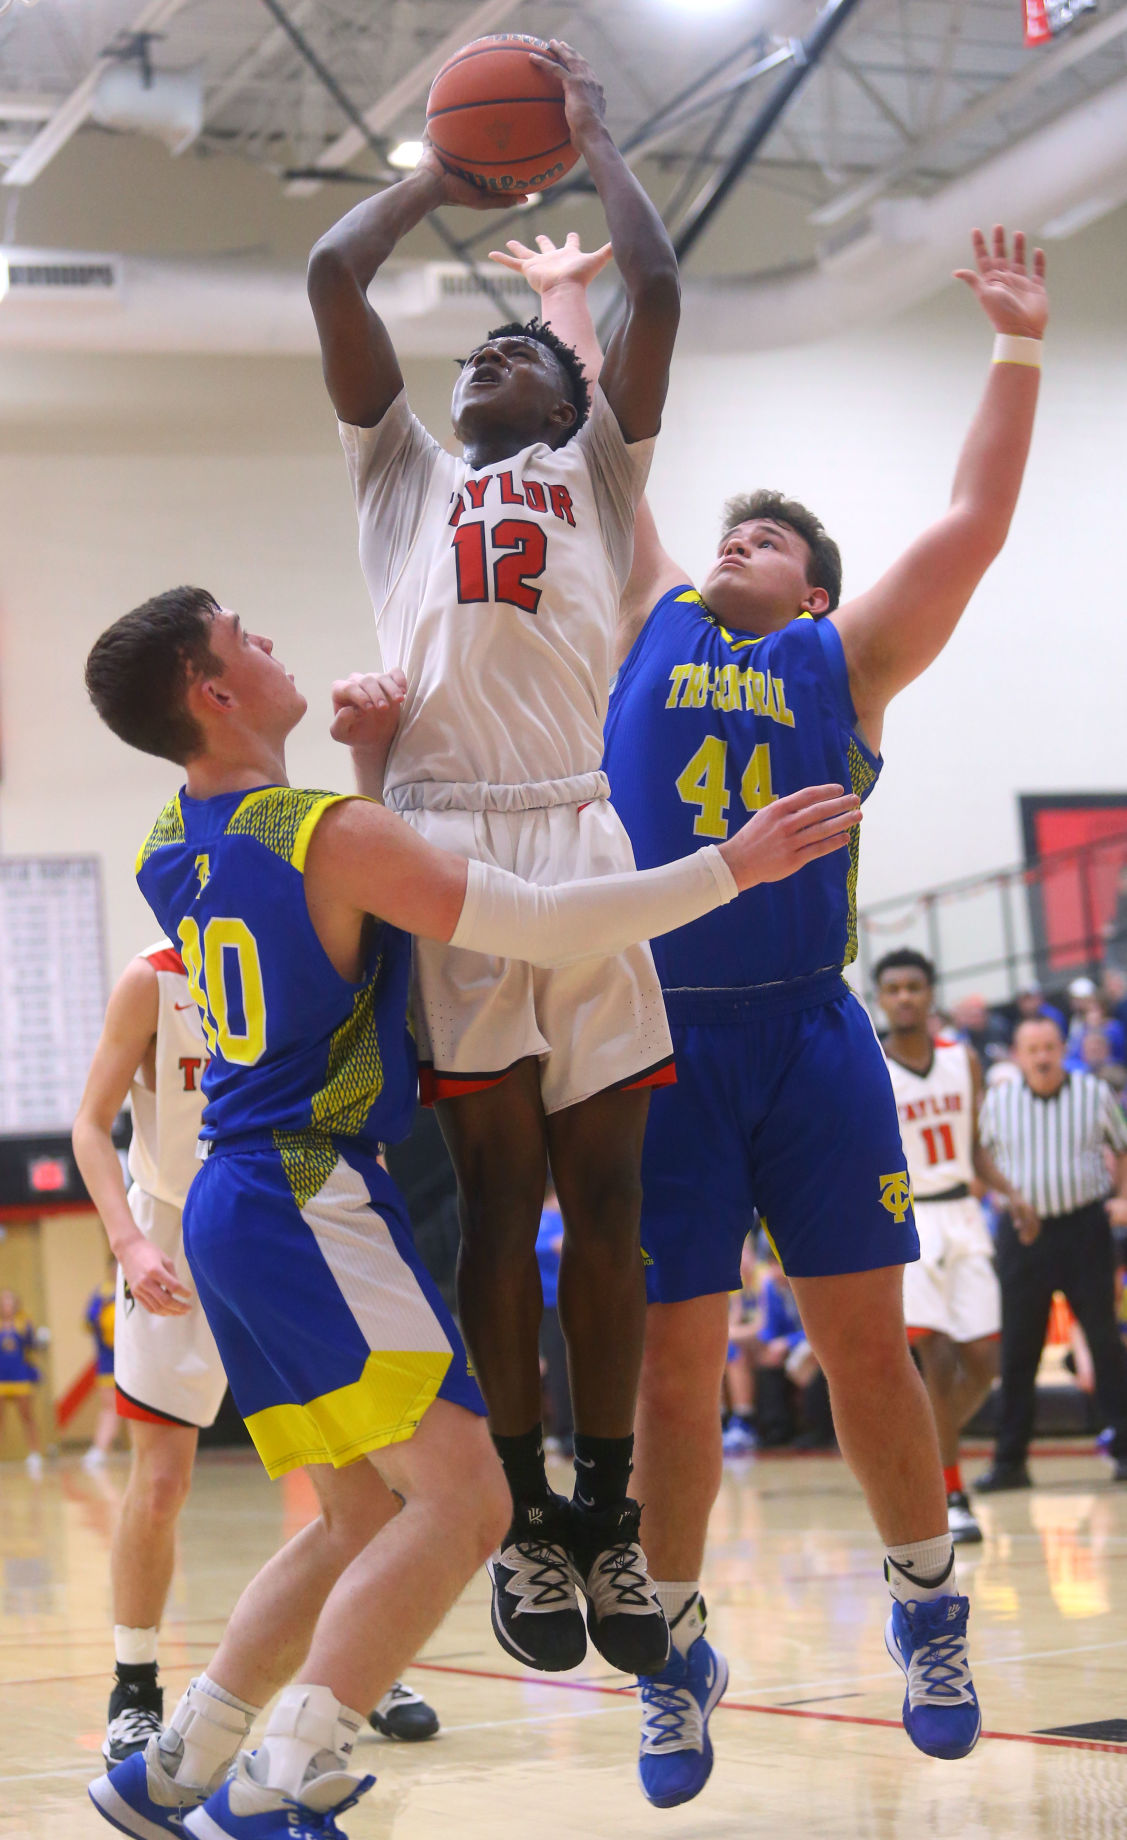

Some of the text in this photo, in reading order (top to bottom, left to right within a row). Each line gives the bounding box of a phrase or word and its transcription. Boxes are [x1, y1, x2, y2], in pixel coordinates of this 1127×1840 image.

[458, 162, 563, 190] Wilson
[448, 470, 576, 528] AYLOR
[451, 518, 547, 614] 12
[675, 734, 779, 839] 44
[921, 1123, 956, 1166] 11
